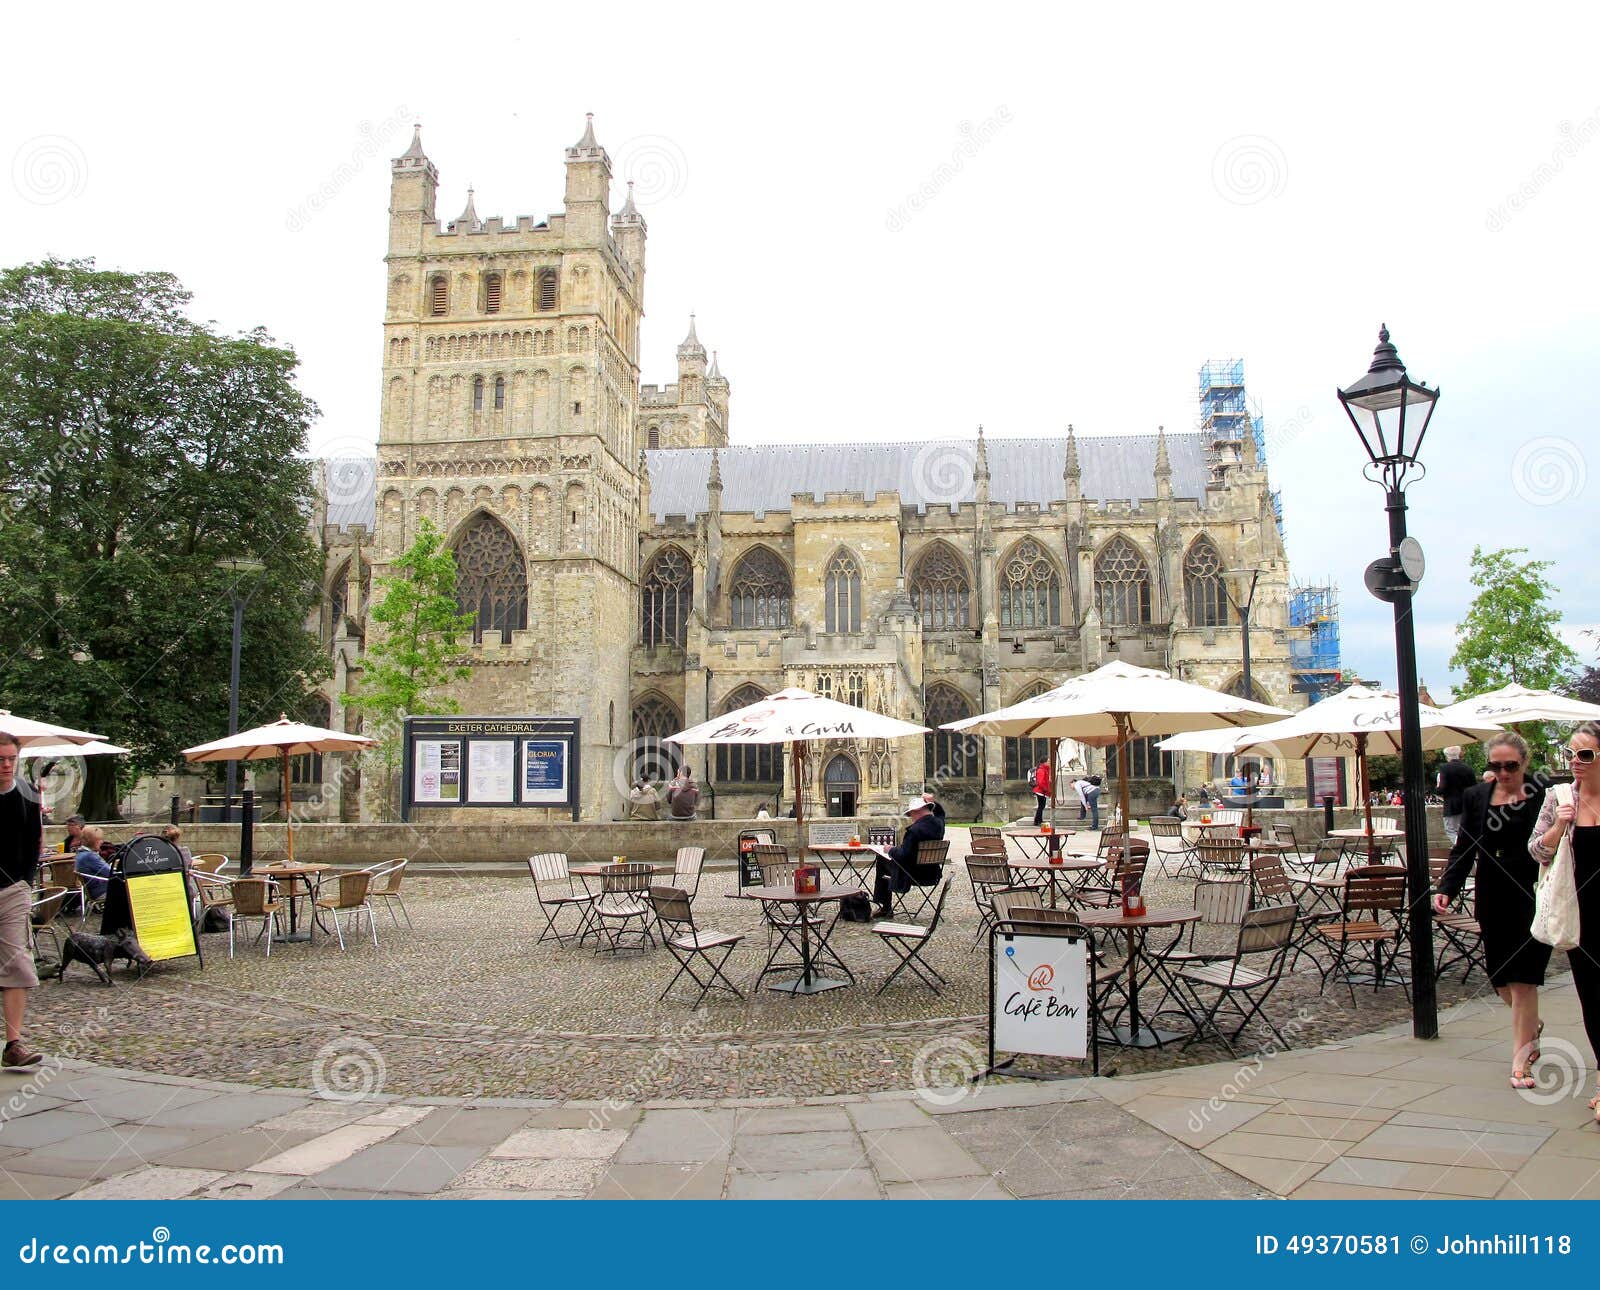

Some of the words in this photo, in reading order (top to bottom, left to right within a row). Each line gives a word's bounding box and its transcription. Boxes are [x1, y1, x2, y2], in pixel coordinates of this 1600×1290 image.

[448, 723, 483, 732] EXETER
[484, 723, 535, 732] CATHEDRAL
[710, 722, 768, 738] Bar
[801, 722, 854, 735] Grill
[1004, 991, 1042, 1021] Café
[1046, 996, 1079, 1018] Bar
